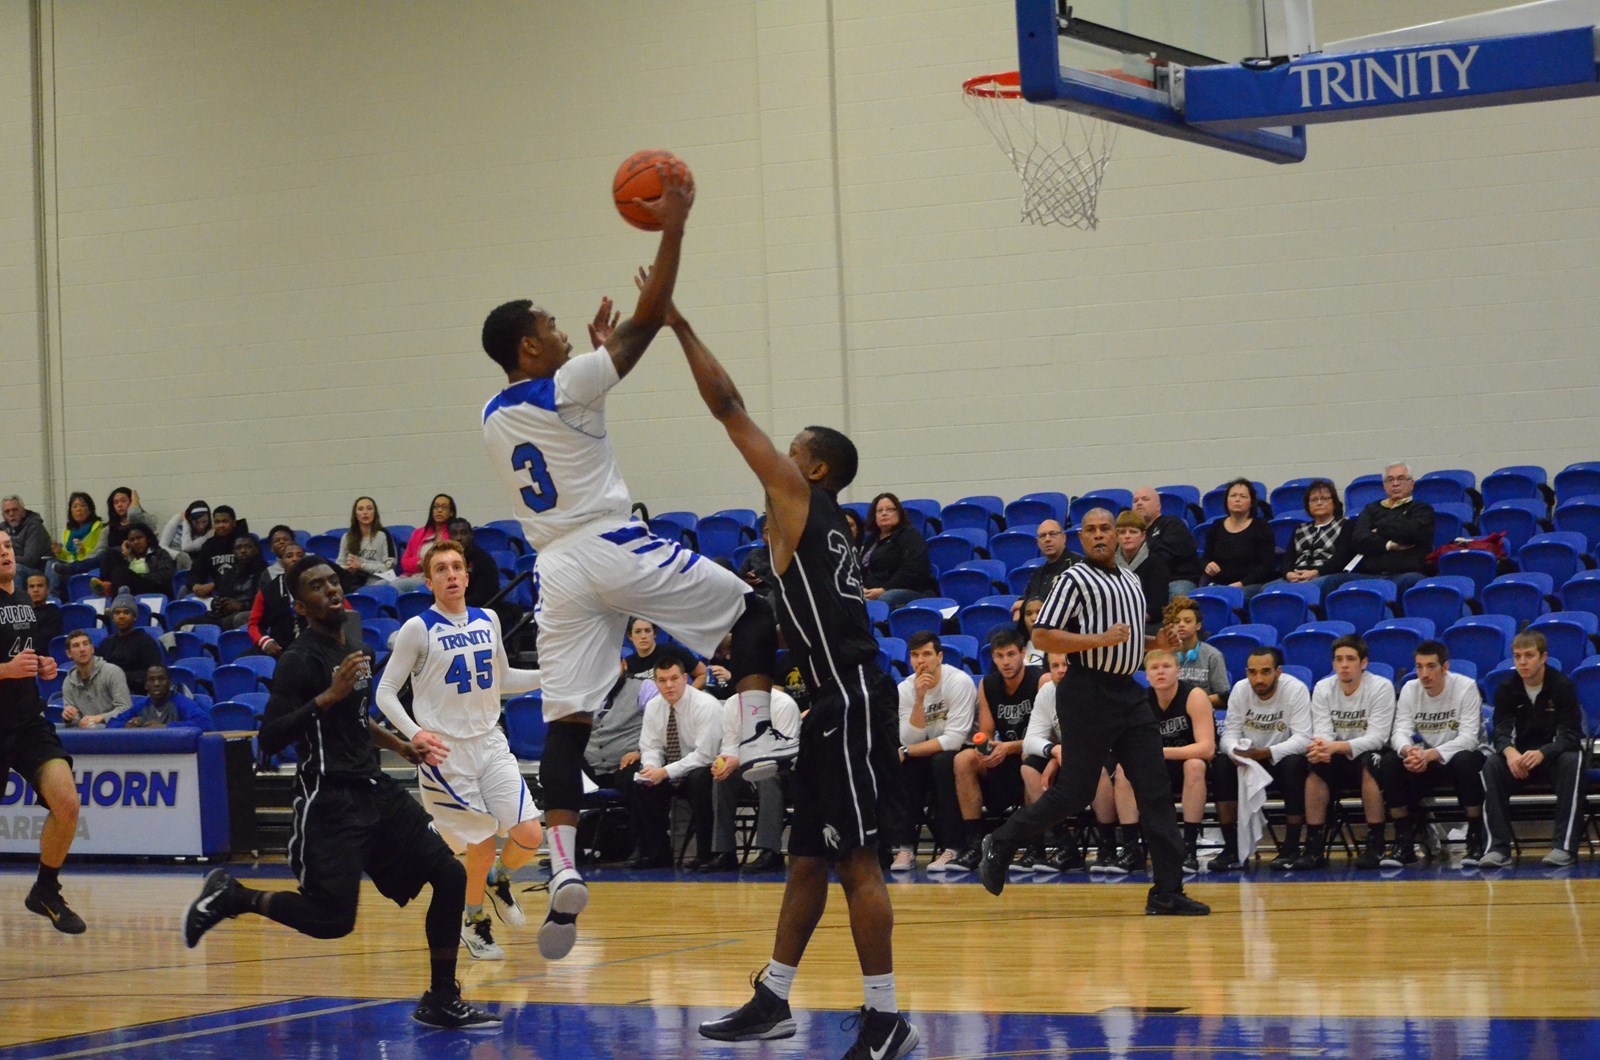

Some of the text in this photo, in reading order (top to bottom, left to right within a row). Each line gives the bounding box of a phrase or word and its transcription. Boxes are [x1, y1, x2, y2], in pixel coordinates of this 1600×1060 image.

[1288, 45, 1480, 108] TRINITY
[511, 441, 558, 514] 3
[211, 554, 235, 565] TRINIT
[0, 604, 37, 625] PURDUE
[438, 629, 492, 651] TRINITY
[445, 649, 494, 694] 45
[1159, 716, 1188, 735] RDUE
[0, 815, 91, 841] AREA
